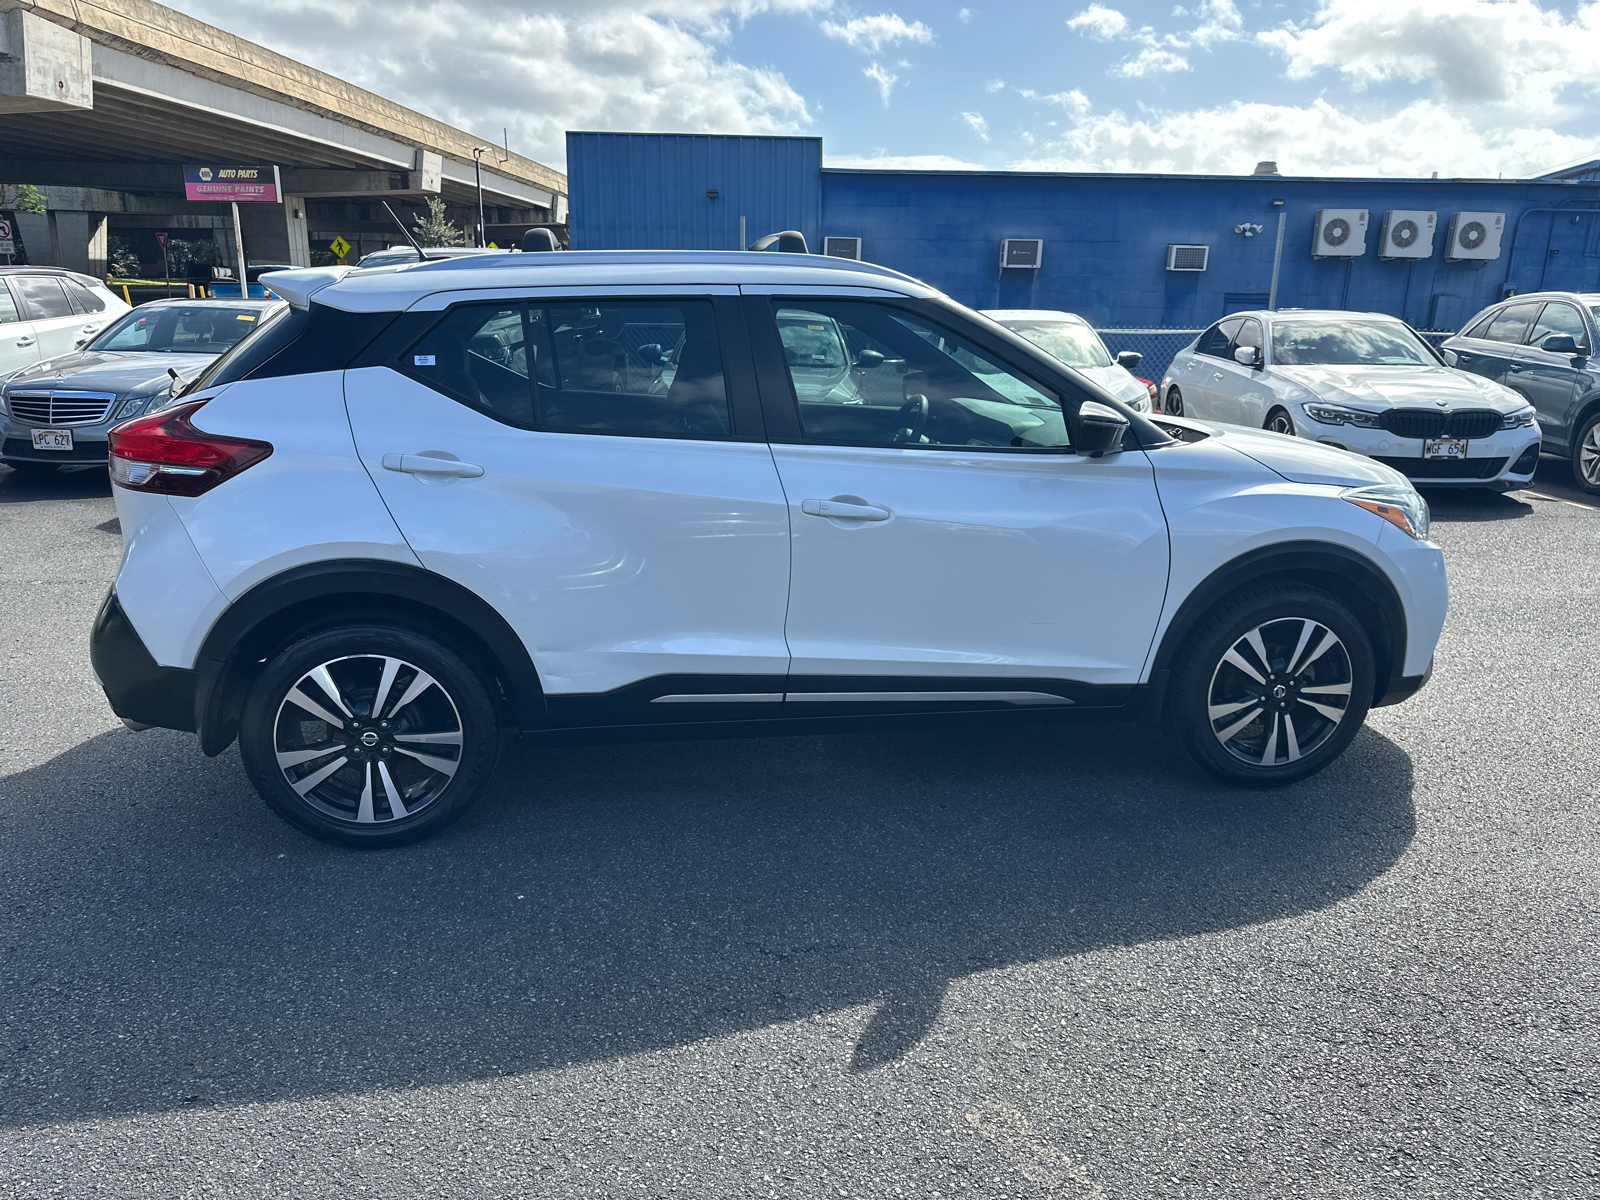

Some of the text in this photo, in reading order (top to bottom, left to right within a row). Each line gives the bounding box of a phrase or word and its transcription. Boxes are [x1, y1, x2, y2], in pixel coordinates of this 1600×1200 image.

[218, 169, 236, 178] AUTO
[237, 170, 258, 178] PARTS
[33, 434, 70, 446] LPC 627
[1426, 442, 1465, 455] WGF 654
